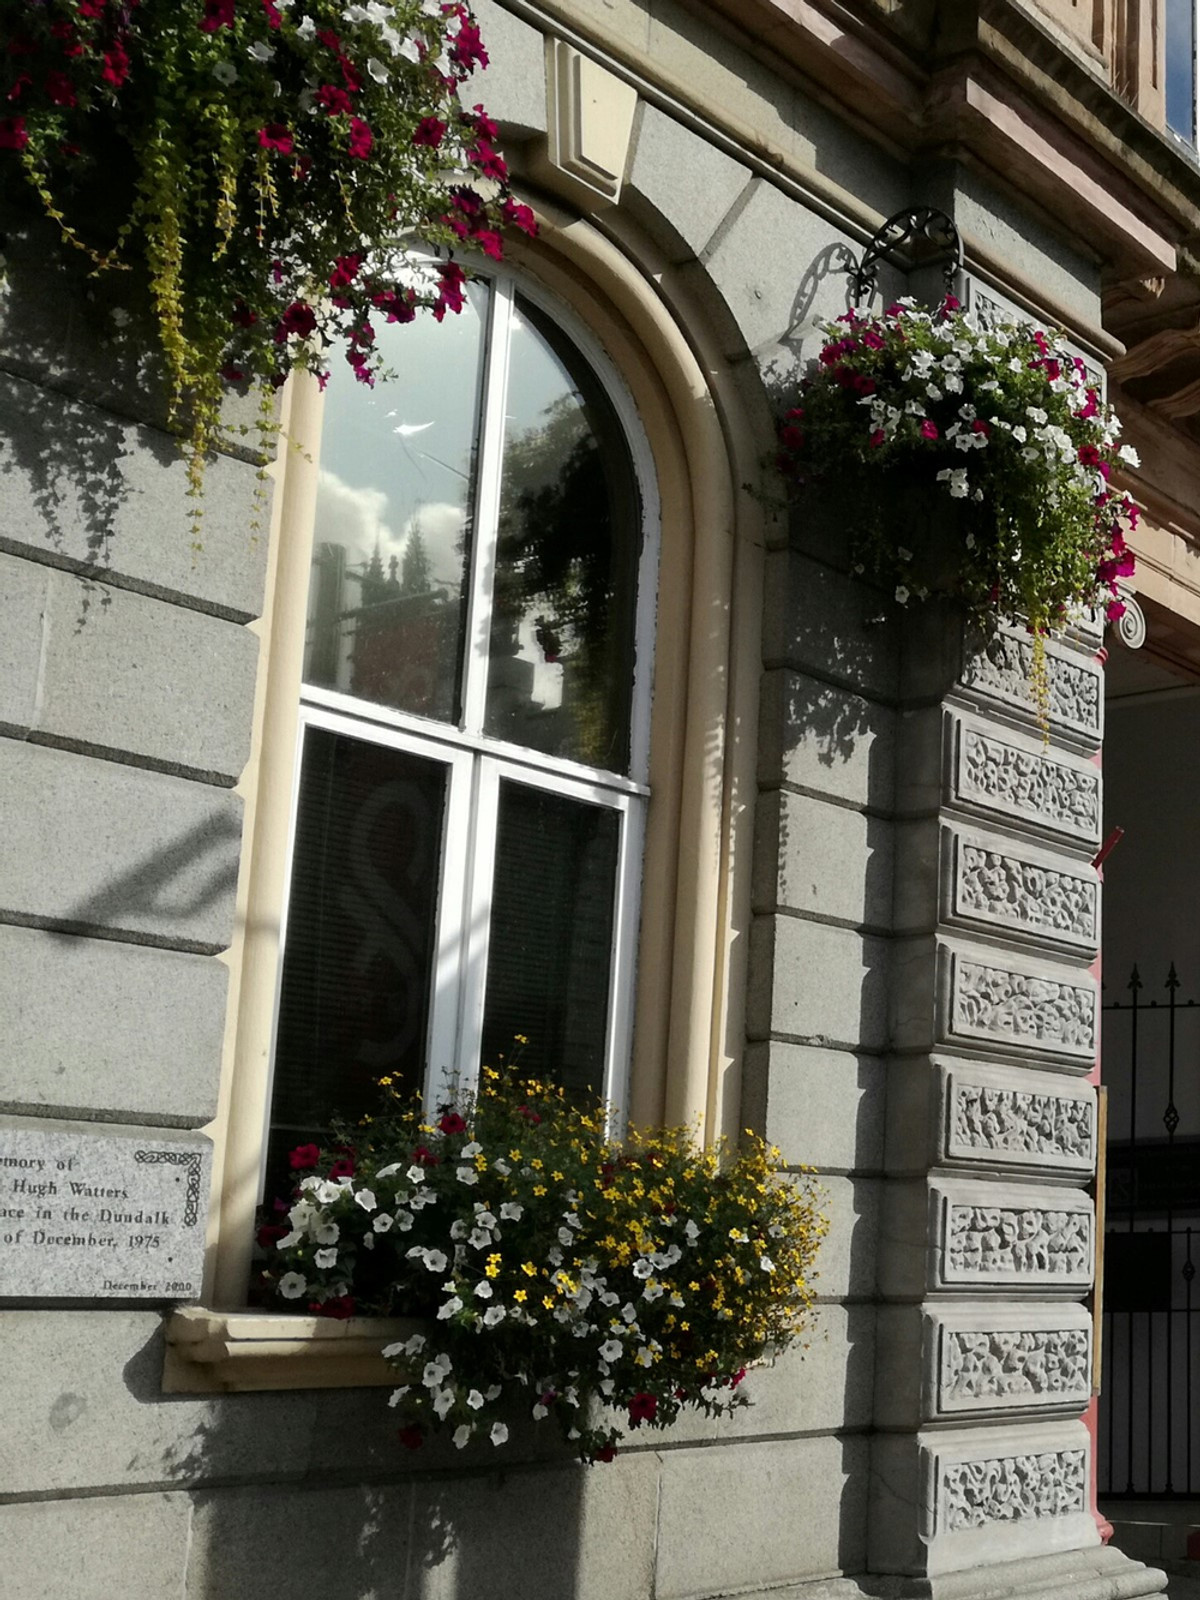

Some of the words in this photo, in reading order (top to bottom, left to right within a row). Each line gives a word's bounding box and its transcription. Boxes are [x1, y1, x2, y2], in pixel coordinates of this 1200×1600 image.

[56, 1157, 76, 1171] of
[13, 1178, 58, 1197] Hugh
[69, 1181, 129, 1199] Watters
[36, 1207, 52, 1220] in
[63, 1207, 90, 1222] the
[100, 1208, 170, 1225] Dundalk
[3, 1230, 24, 1244] of
[128, 1234, 161, 1249] 1975
[103, 1280, 158, 1291] December
[165, 1281, 192, 1292] 2000
